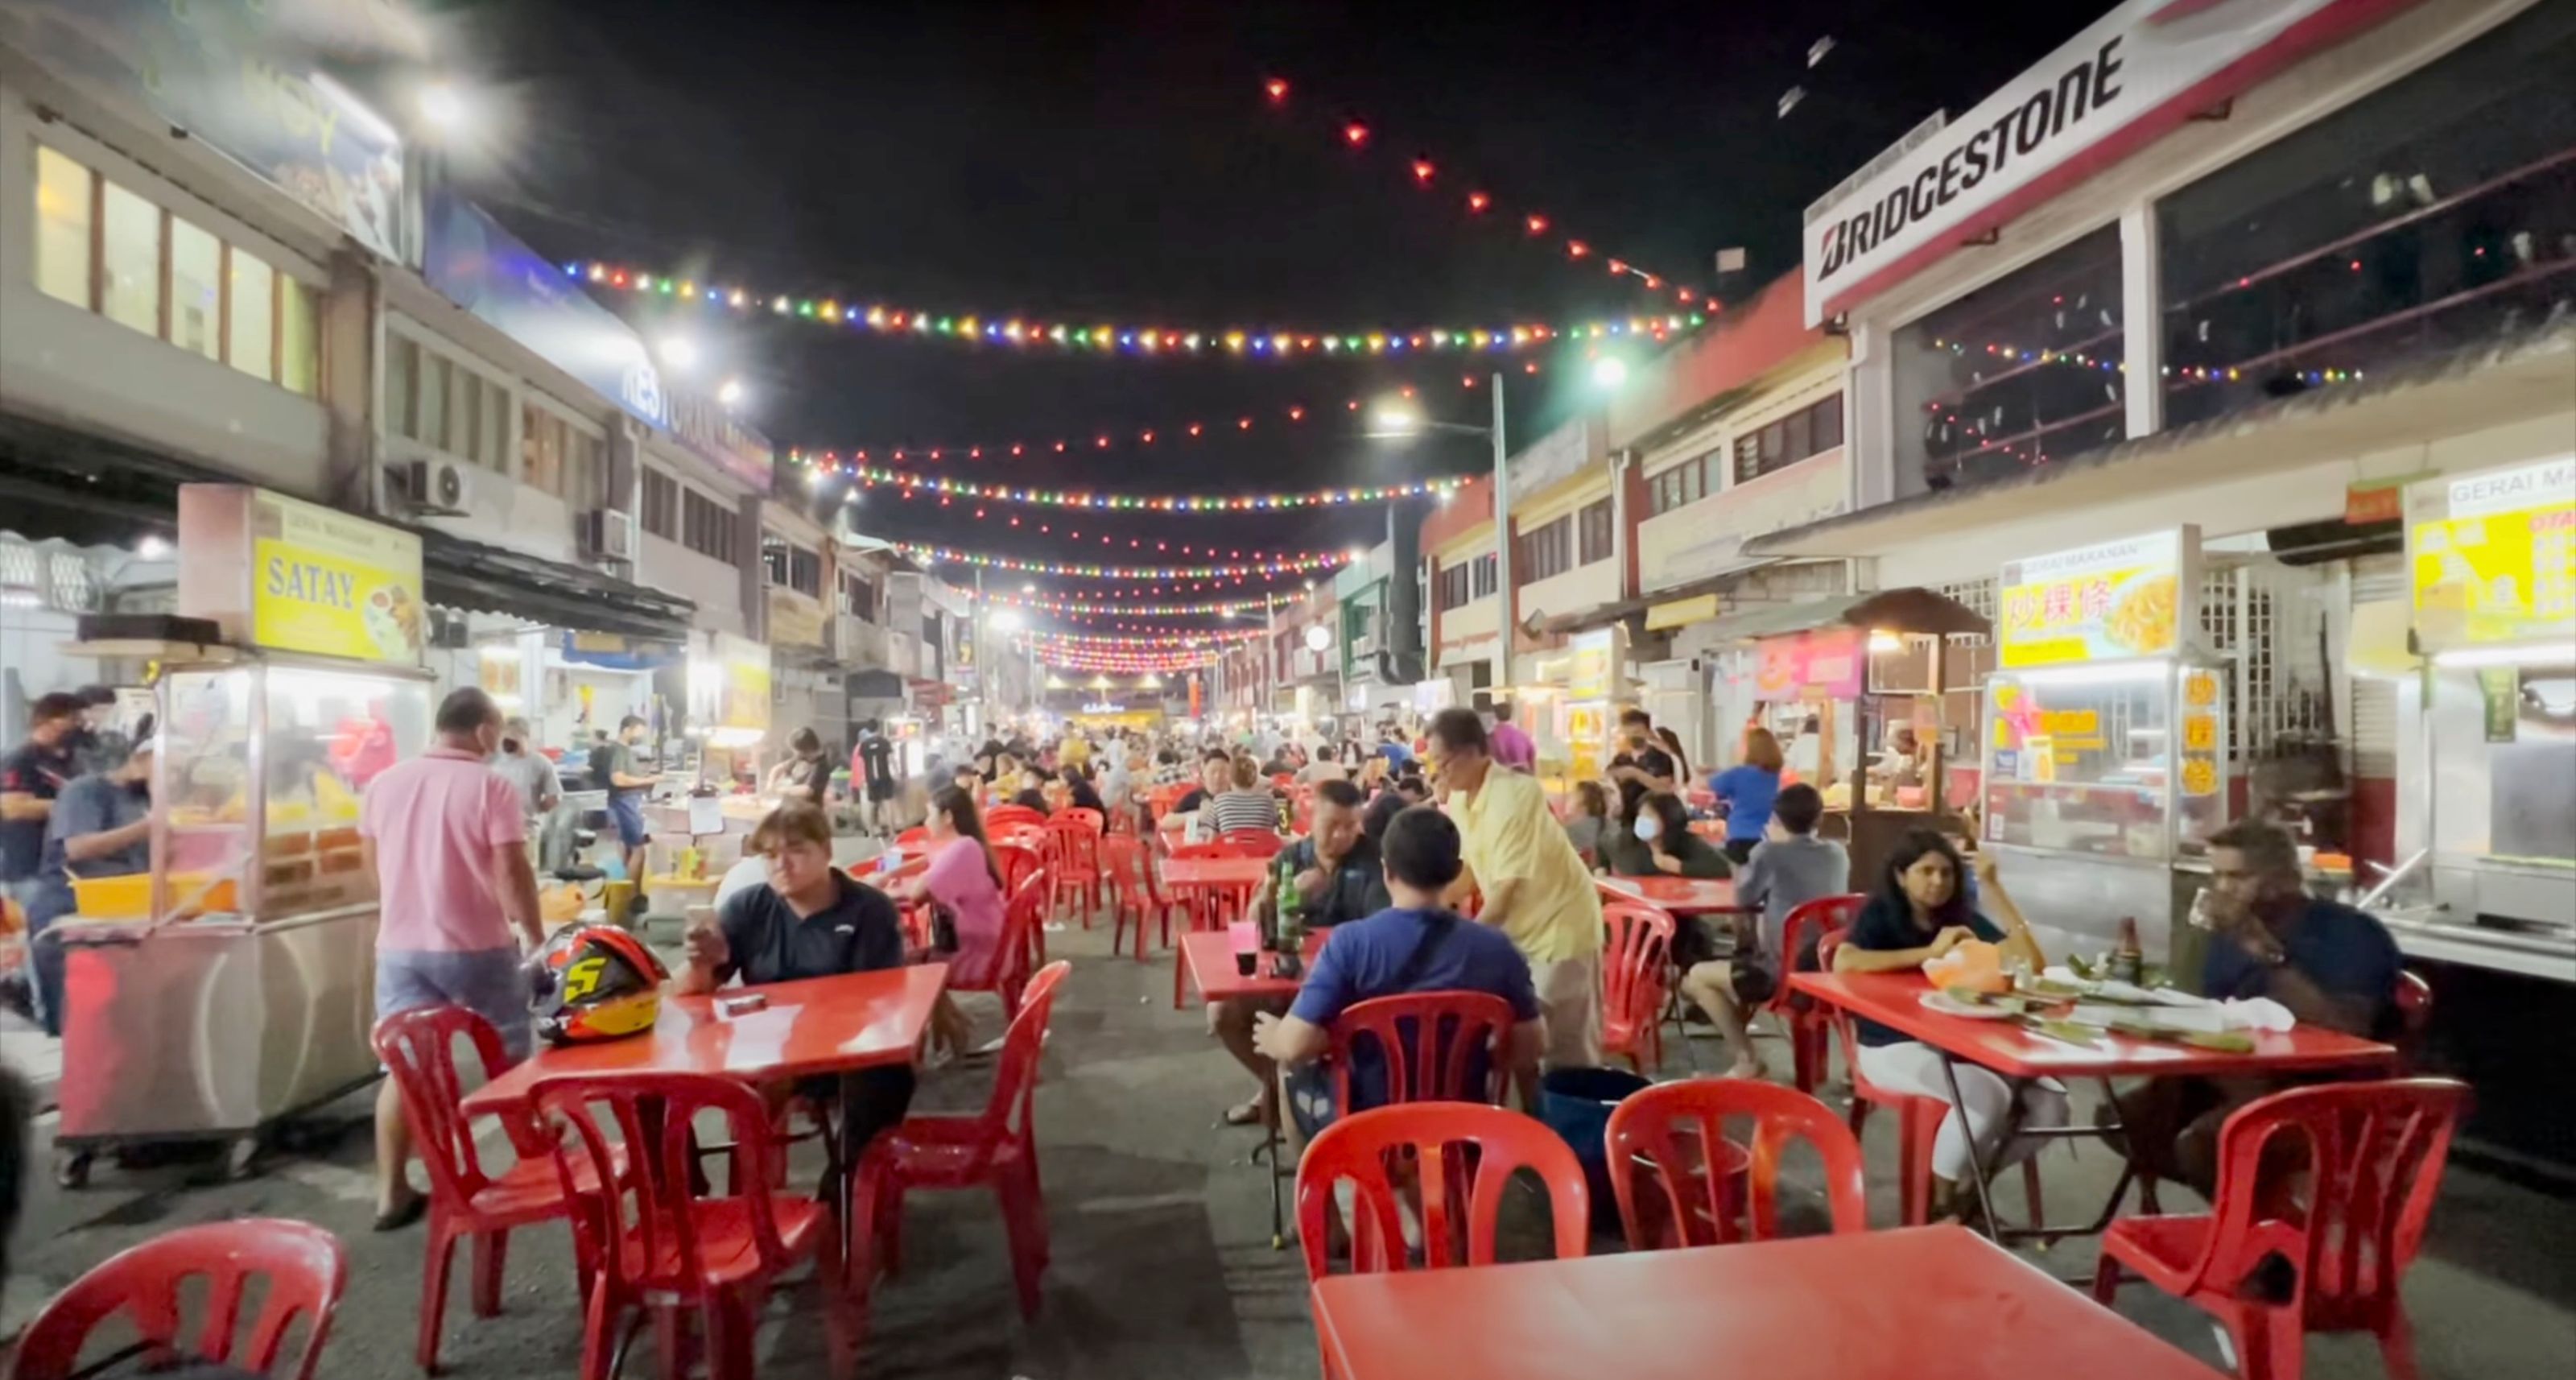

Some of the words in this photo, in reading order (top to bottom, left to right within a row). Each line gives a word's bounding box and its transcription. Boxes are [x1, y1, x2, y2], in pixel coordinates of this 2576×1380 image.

[1818, 35, 2125, 283] BRIDGESTONE
[2452, 472, 2533, 502] GERAI
[266, 556, 355, 610] SATAY
